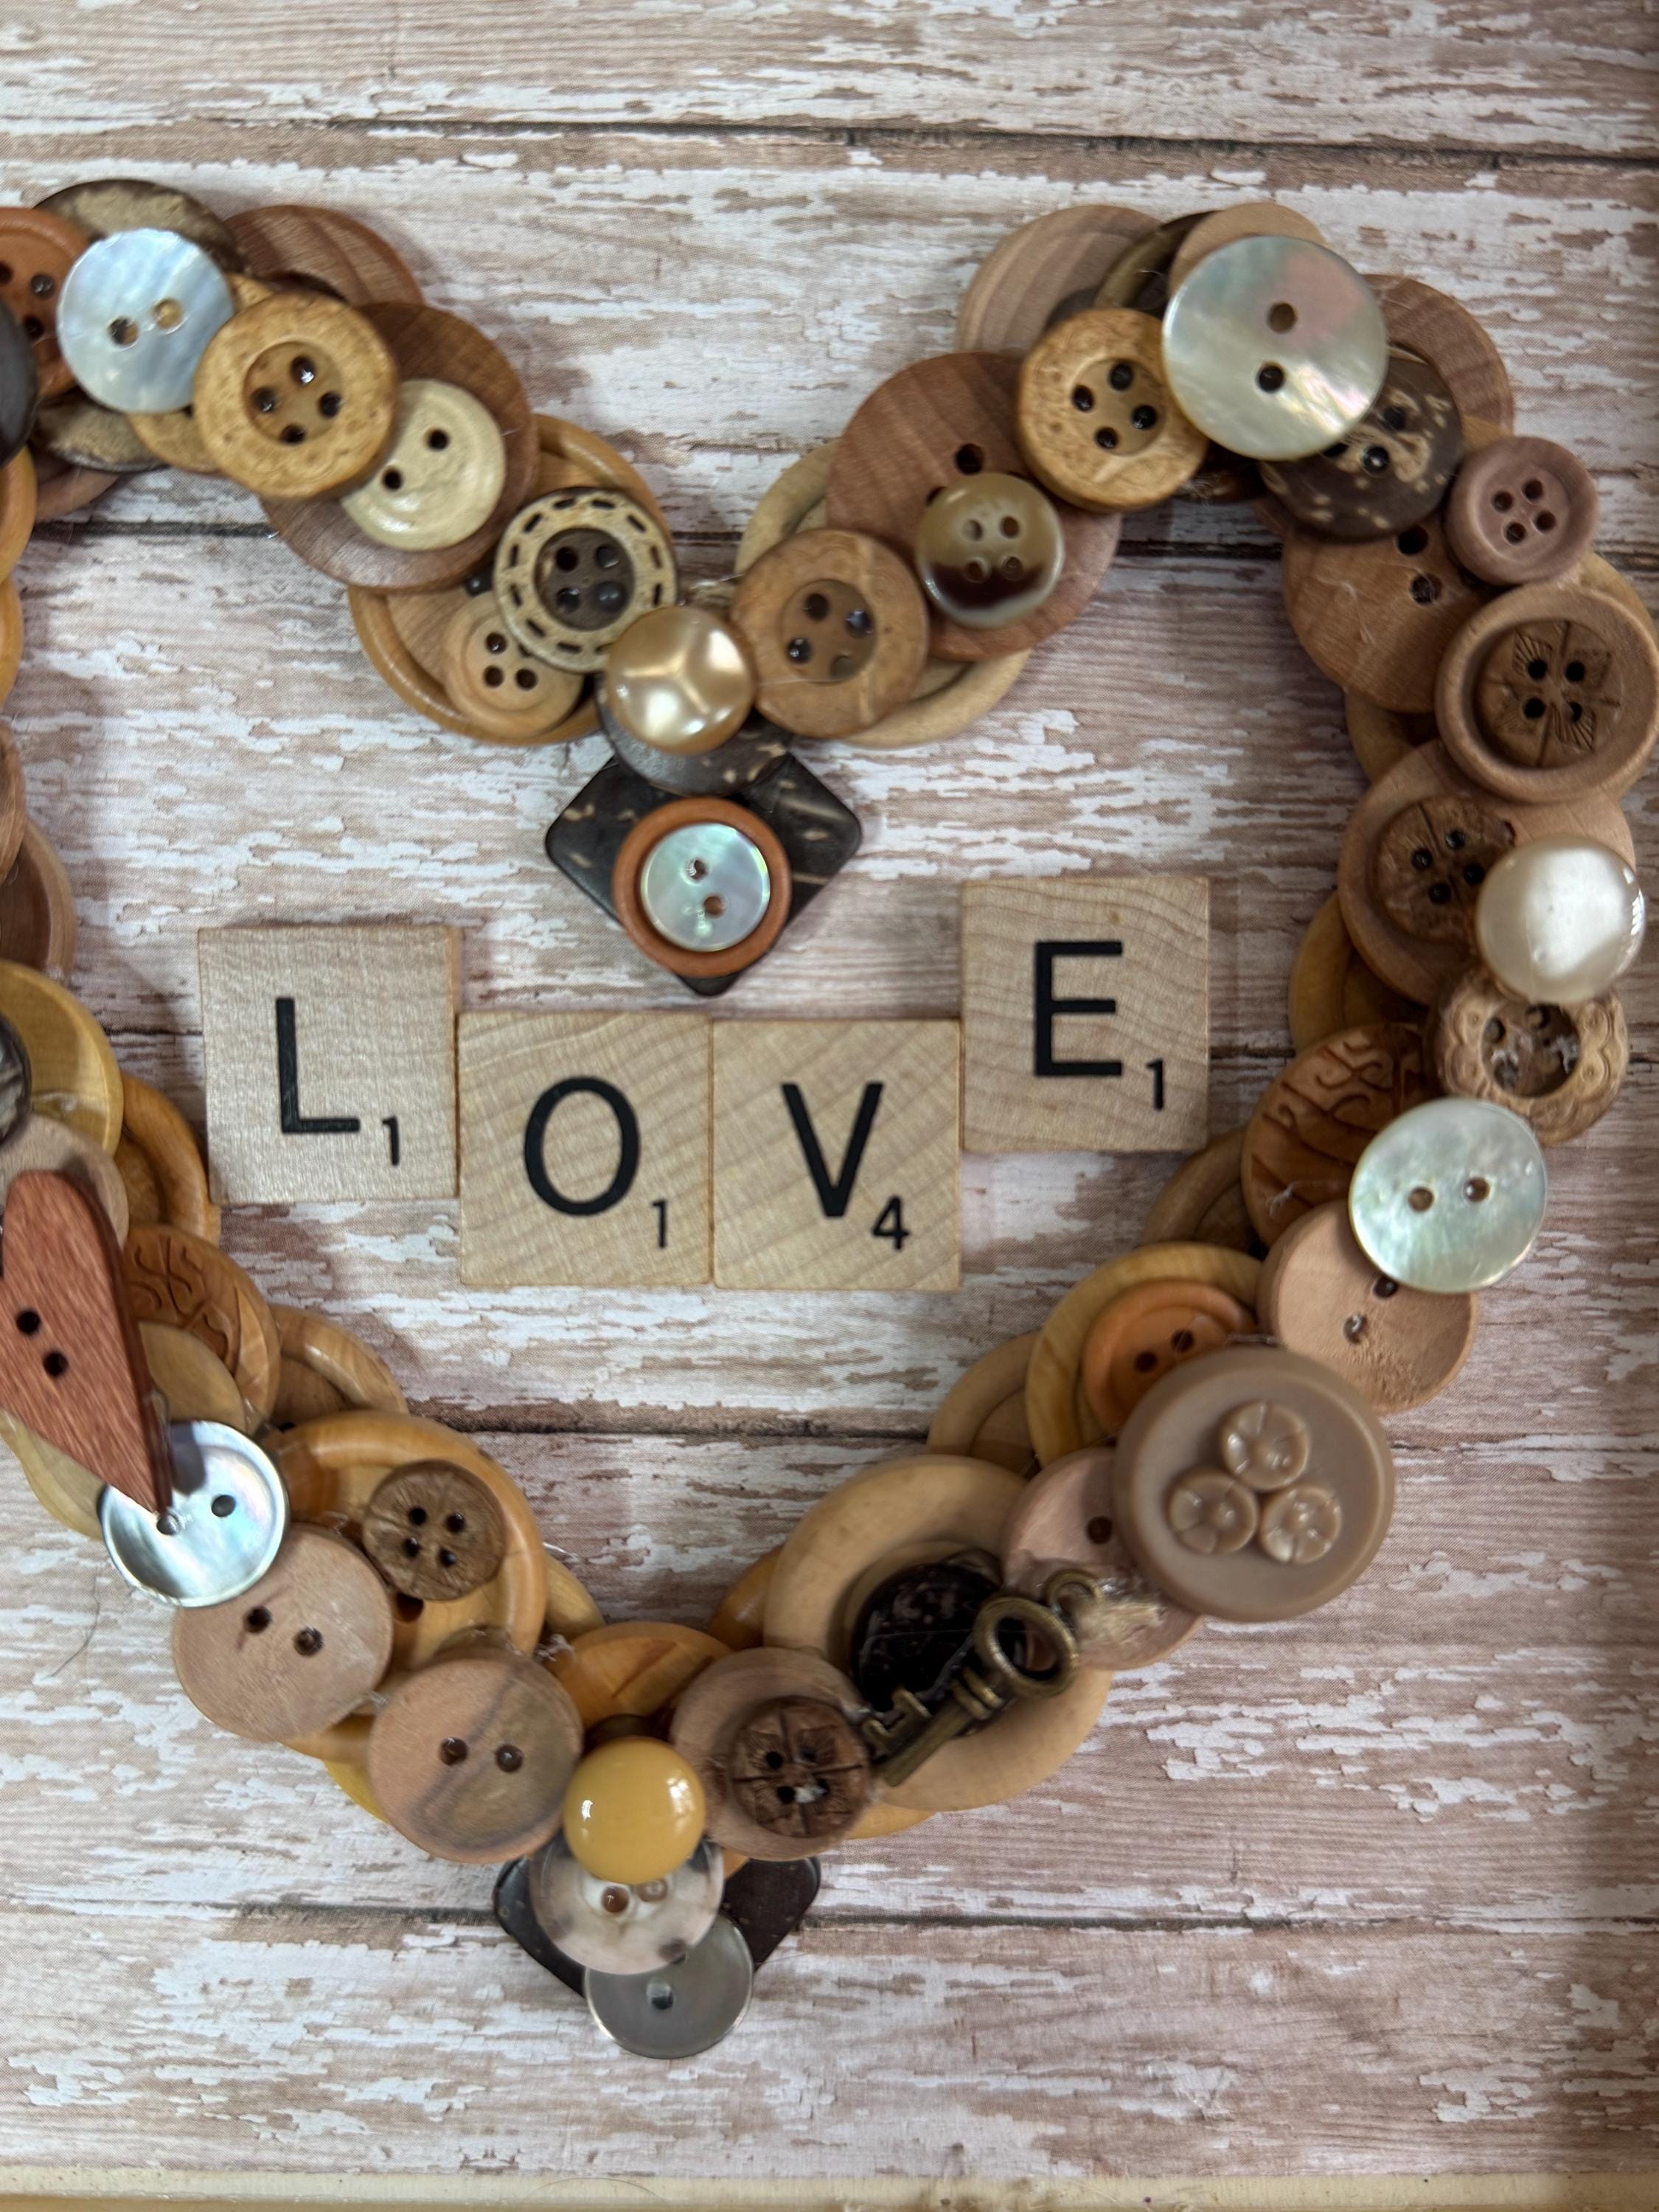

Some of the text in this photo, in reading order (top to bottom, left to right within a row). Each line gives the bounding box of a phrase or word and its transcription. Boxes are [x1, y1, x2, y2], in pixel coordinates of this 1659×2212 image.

[1145, 1057, 1166, 1113] 1
[380, 1116, 400, 1167] 1
[651, 1199, 667, 1249] 1
[871, 1195, 911, 1252] 4
